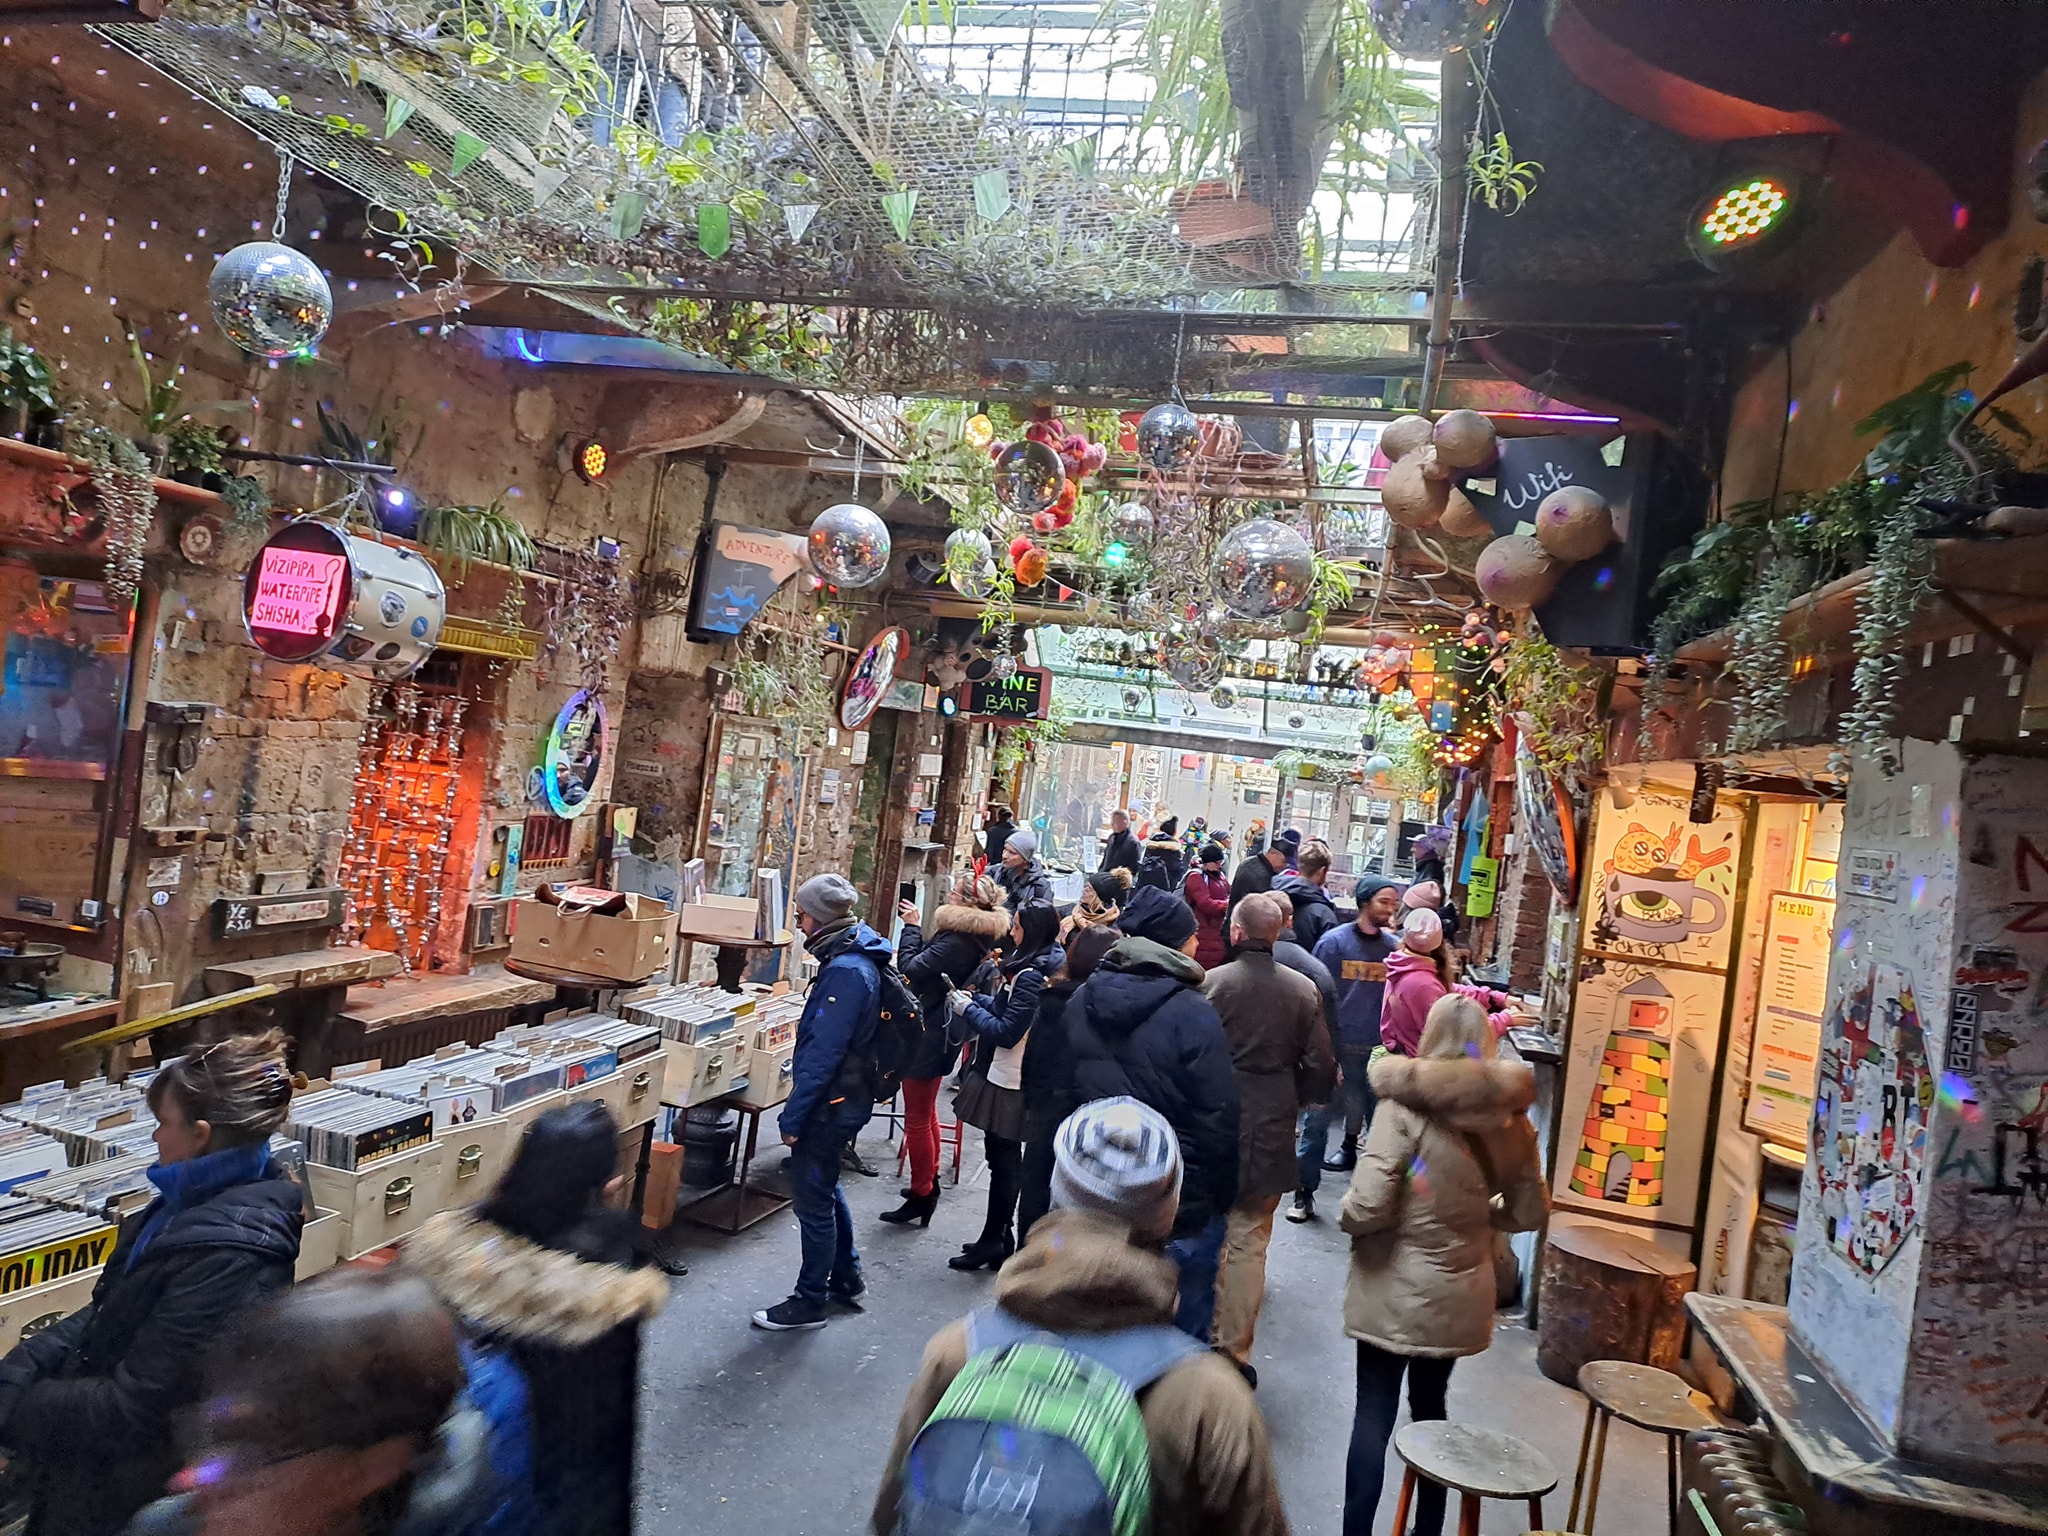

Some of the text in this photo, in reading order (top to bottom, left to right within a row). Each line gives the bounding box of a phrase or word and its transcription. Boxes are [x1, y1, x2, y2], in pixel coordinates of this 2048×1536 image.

[1503, 462, 1573, 509] Wifi
[725, 539, 791, 565] ADVENTURE
[981, 675, 1039, 692] INE
[985, 694, 1028, 712] BAR
[1777, 901, 1814, 916] MENU
[0, 1237, 108, 1294] OLIDAY
